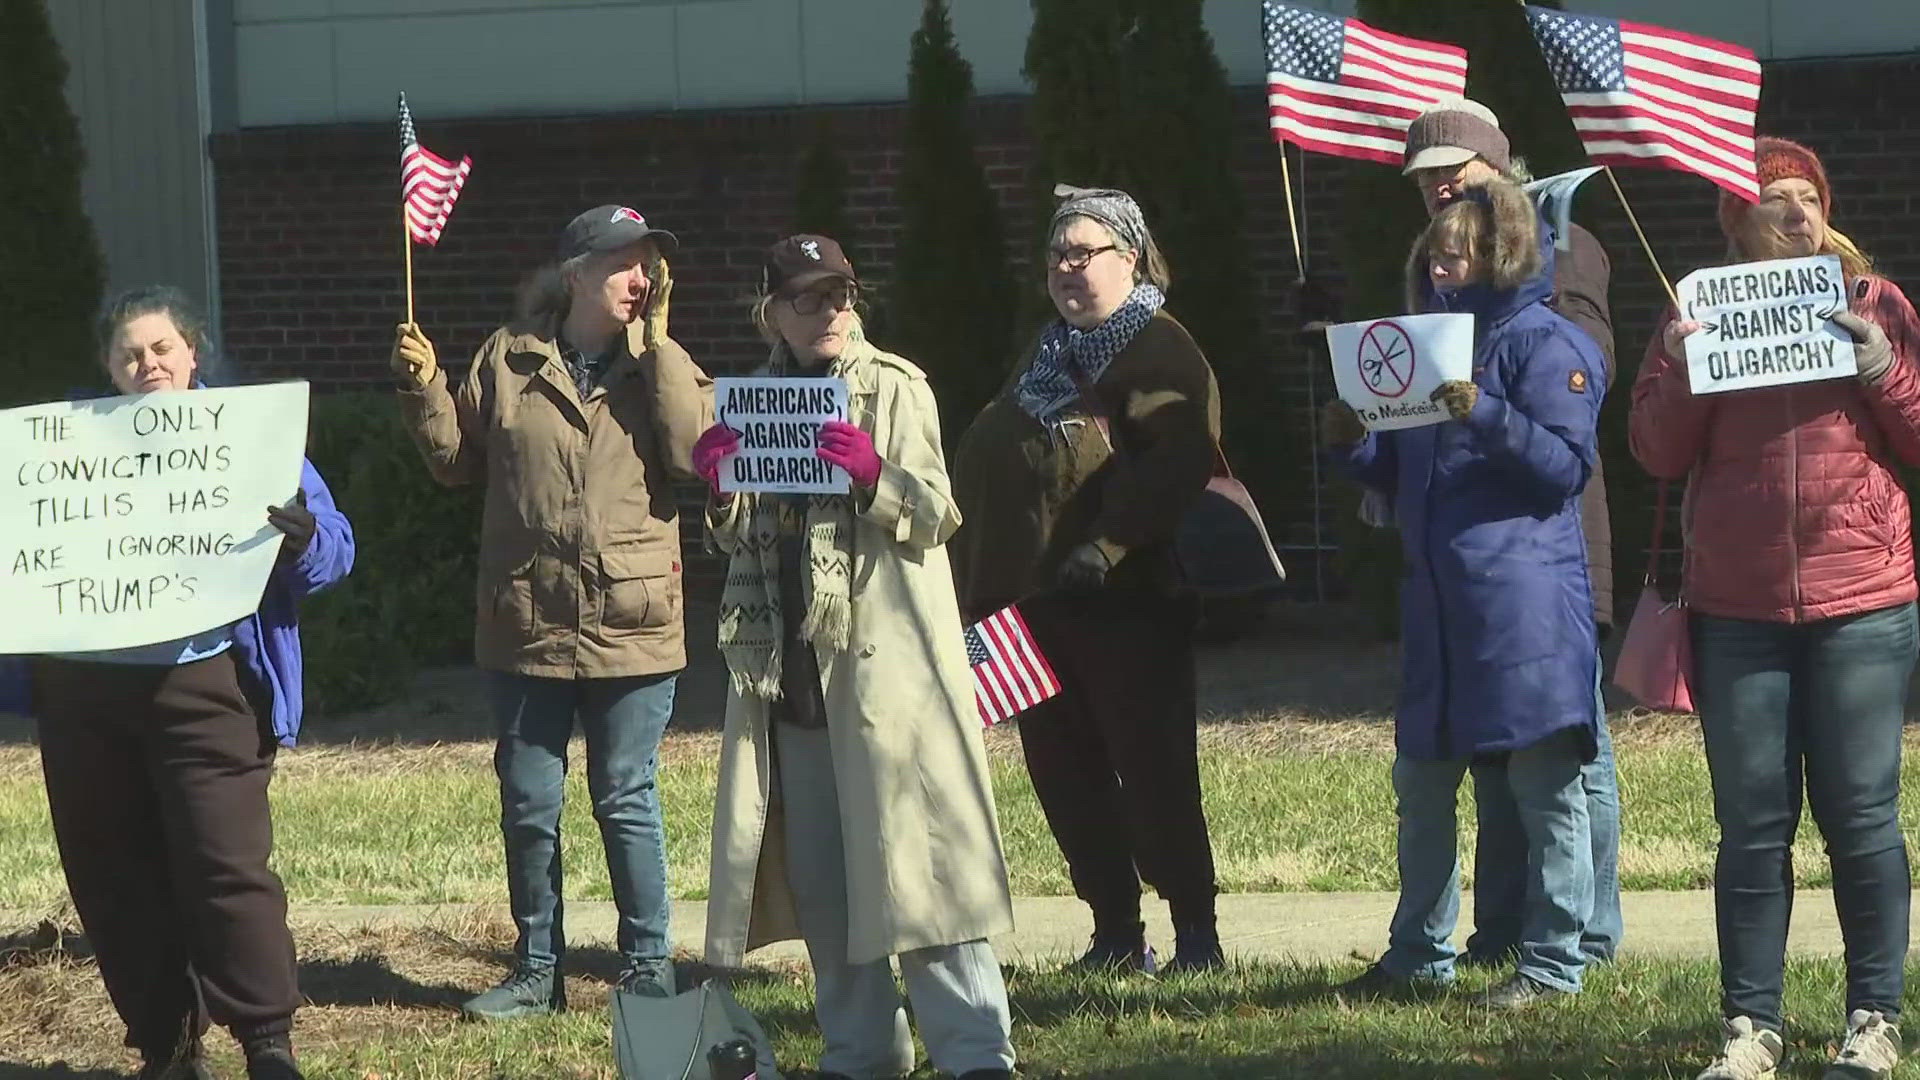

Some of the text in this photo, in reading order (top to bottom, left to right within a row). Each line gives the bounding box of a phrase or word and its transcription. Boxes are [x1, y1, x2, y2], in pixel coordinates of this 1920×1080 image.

[1696, 265, 1830, 307] AMERICANS
[1720, 303, 1816, 342] AGAINST
[1707, 339, 1835, 381] OLIGARCHY
[727, 387, 835, 415] AMERICANS
[1357, 400, 1440, 422] To Medicaid
[24, 403, 225, 443] THE ONLY
[744, 422, 821, 450] AGAINST
[18, 445, 231, 486] CONVICTIONS
[733, 456, 833, 484] OLIGARCHY
[30, 485, 230, 527] TILLIS HAS
[12, 533, 235, 576] ARE IGNORING
[42, 573, 200, 615] TRUMP'S
